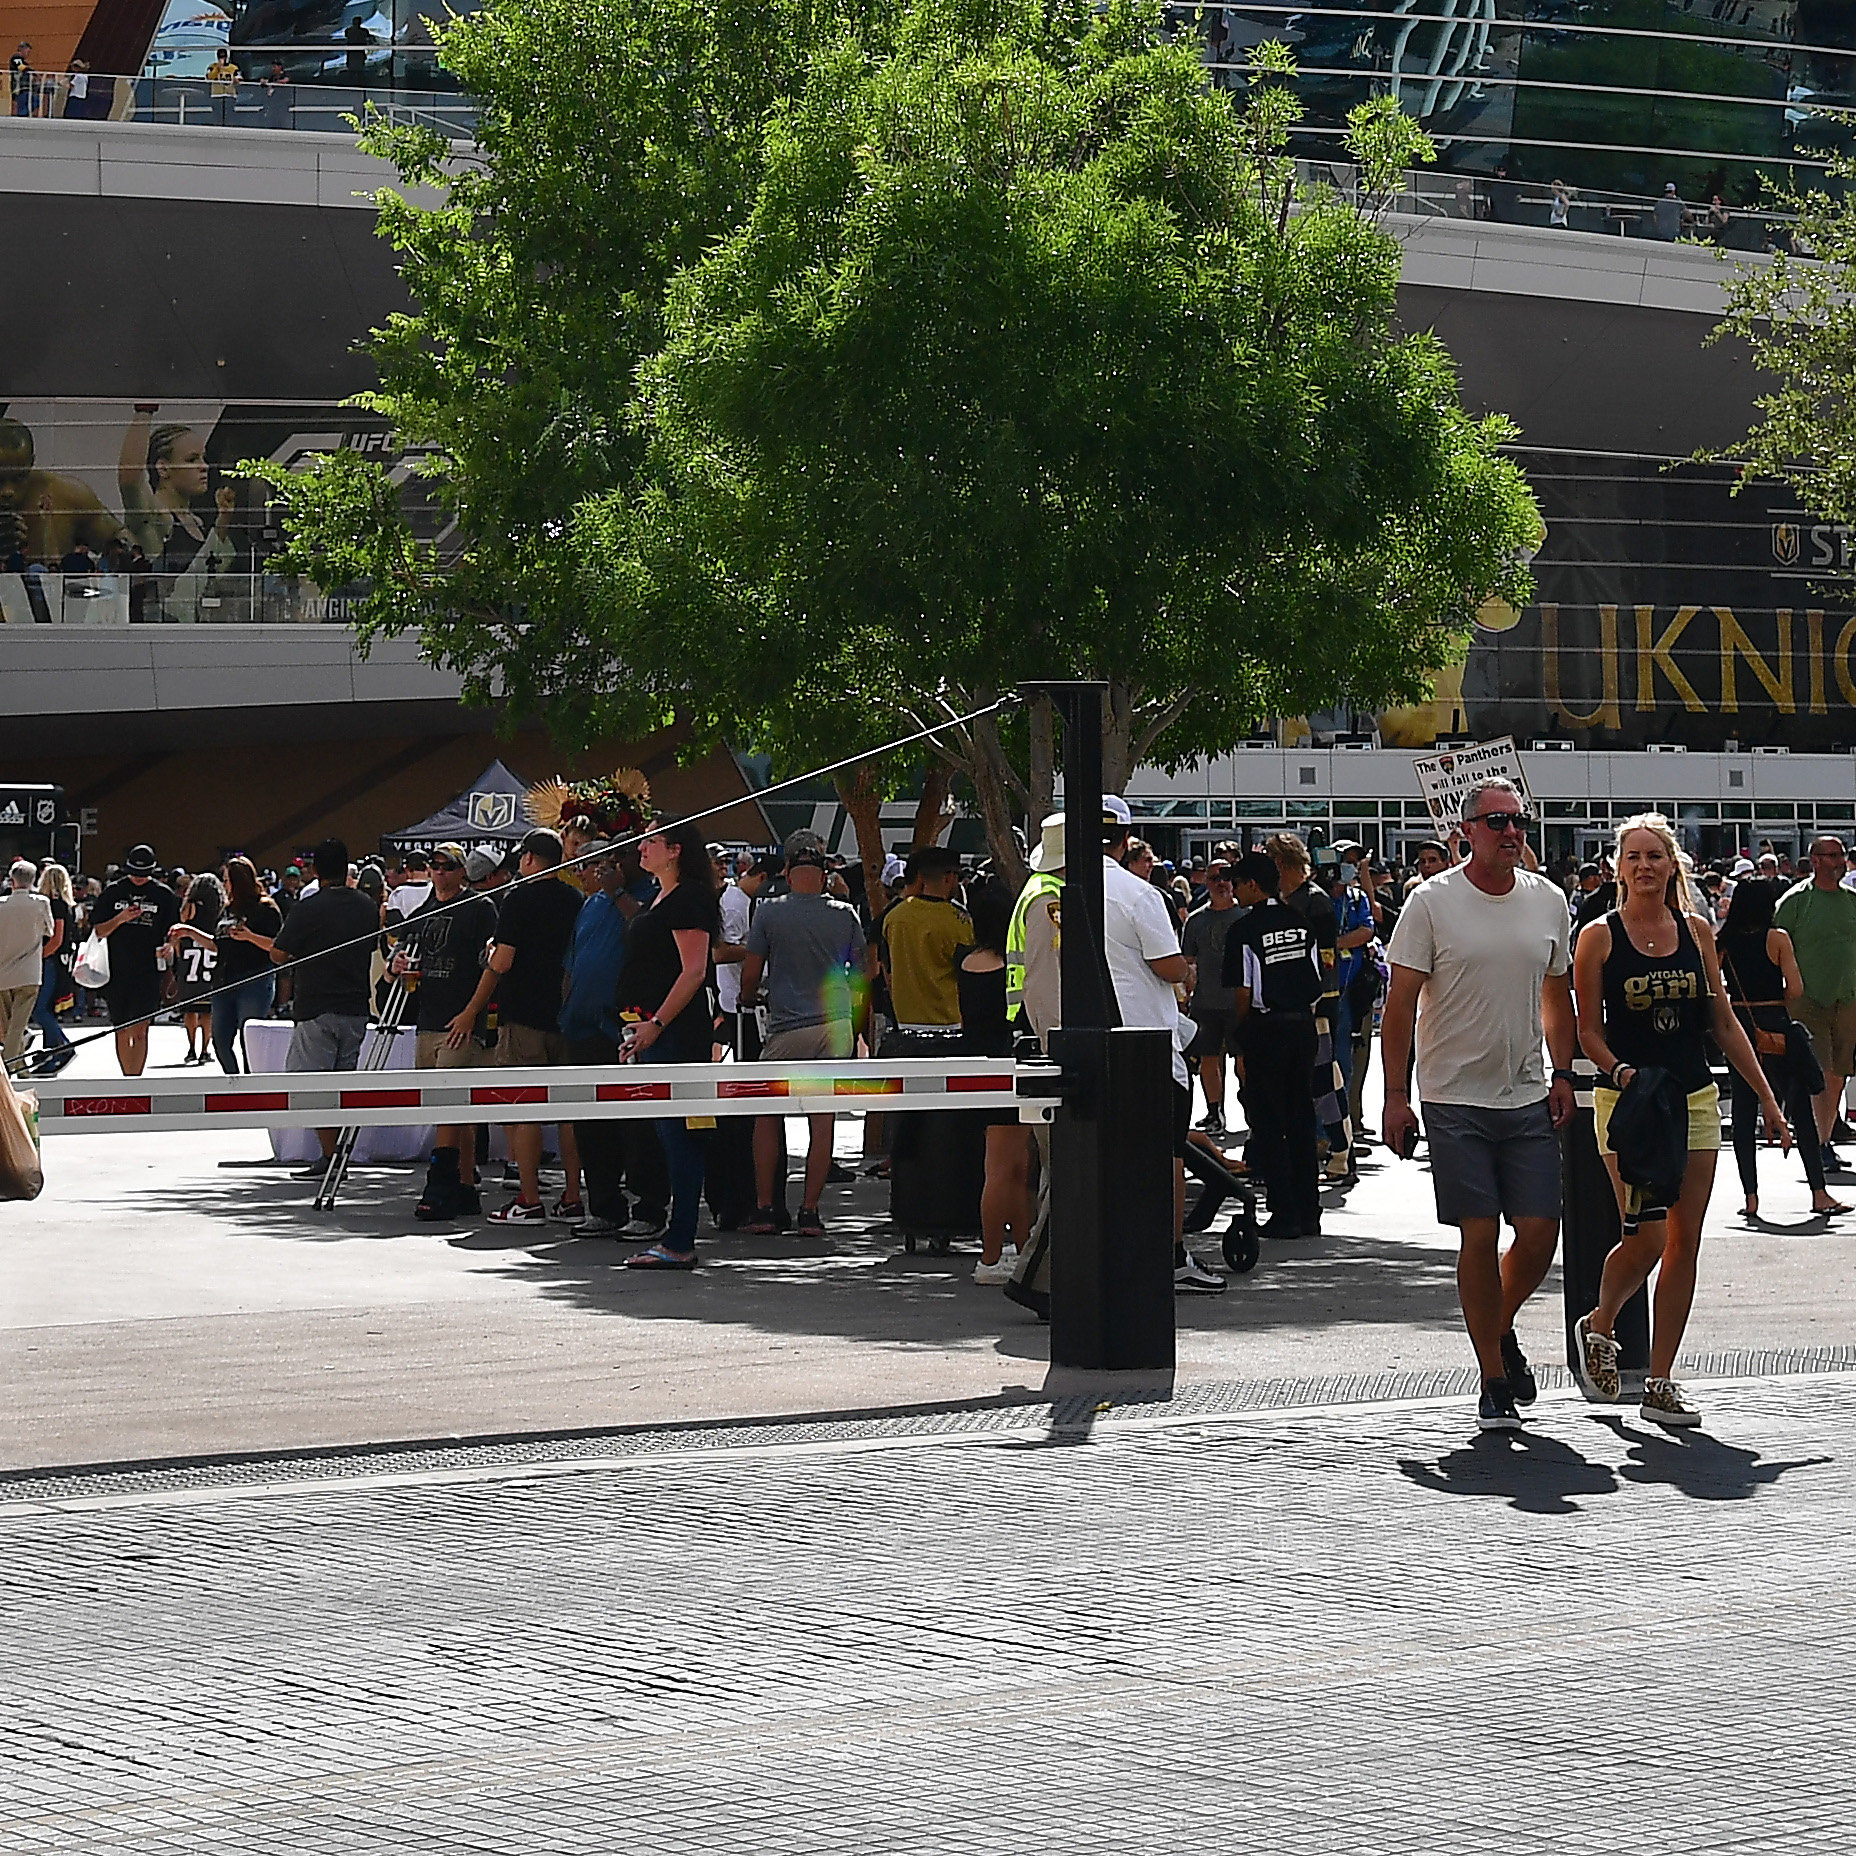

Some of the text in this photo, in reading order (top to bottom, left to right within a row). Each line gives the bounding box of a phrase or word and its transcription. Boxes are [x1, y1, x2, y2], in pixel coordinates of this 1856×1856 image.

[1417, 743, 1512, 774] The Panthers
[1431, 765, 1508, 790] will fall to the
[1262, 928, 1308, 948] BEST
[183, 948, 218, 982] 75
[1648, 969, 1684, 980] VEGAS
[1624, 971, 1698, 1011] girl
